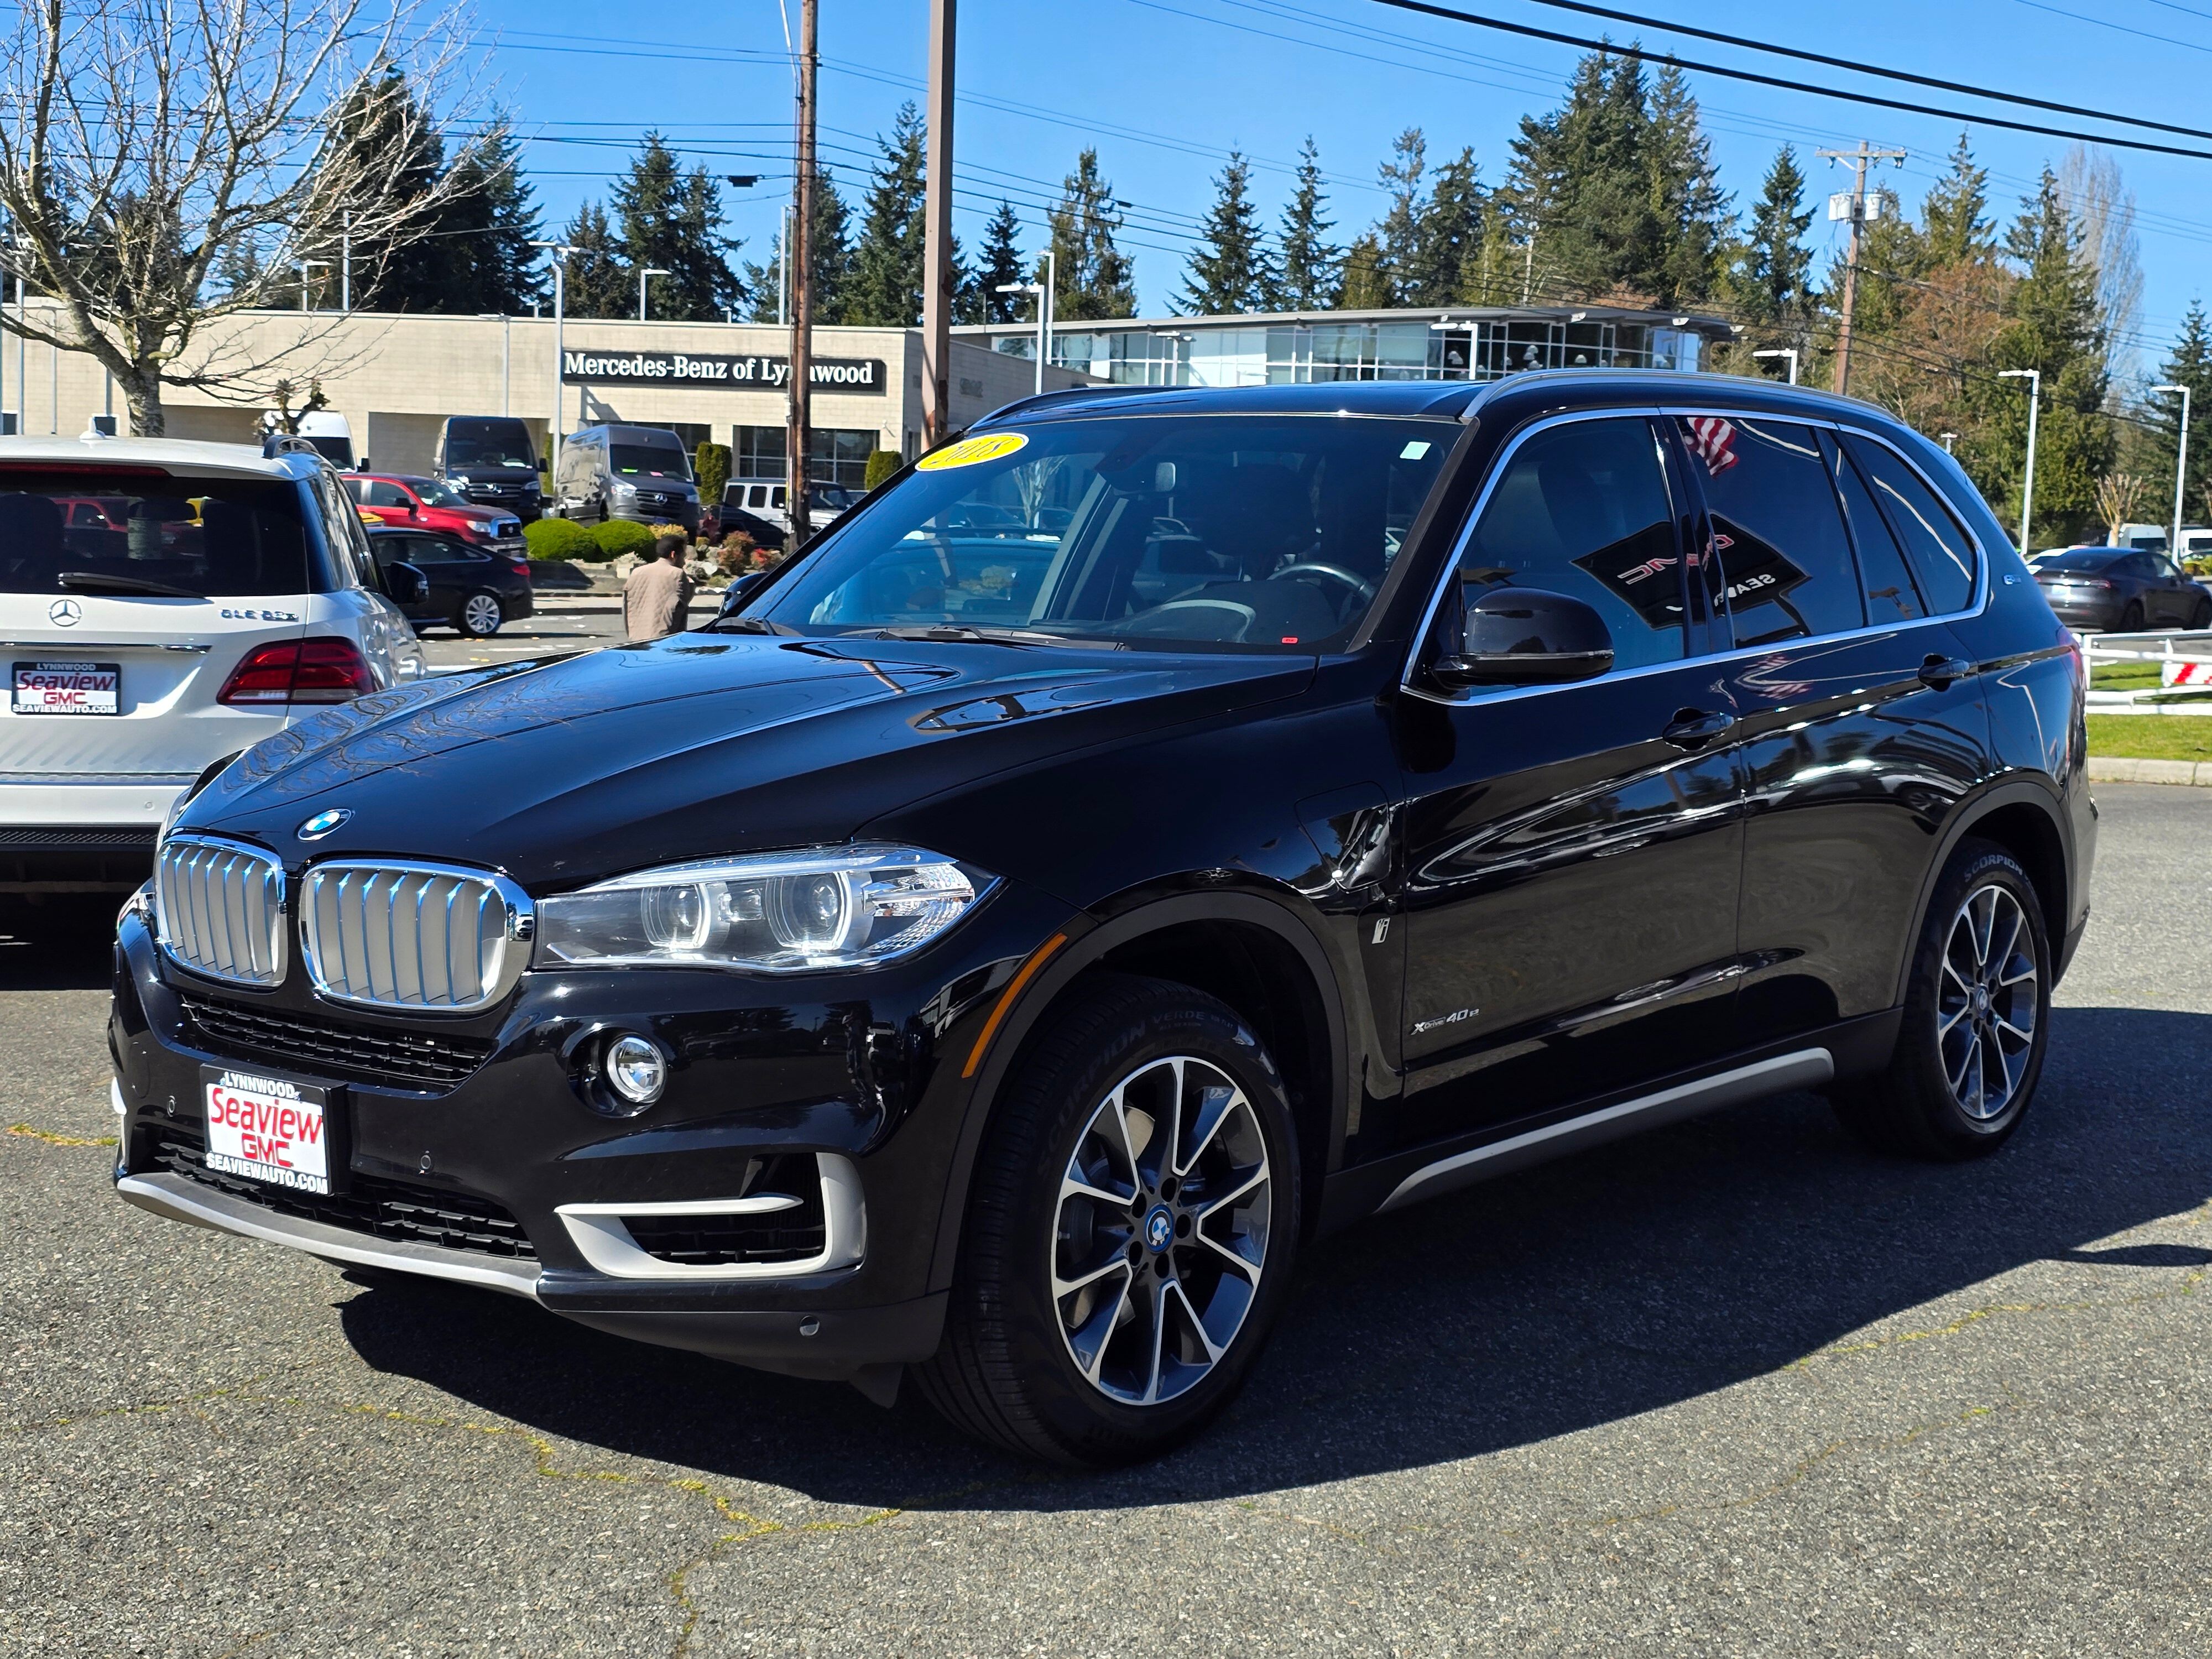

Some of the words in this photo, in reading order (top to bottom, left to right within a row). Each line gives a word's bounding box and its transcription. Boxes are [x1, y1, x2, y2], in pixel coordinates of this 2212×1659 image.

[564, 352, 727, 379] Mercedes-Benz
[733, 358, 756, 380] of
[761, 358, 873, 386] Lywood
[36, 663, 96, 671] LYNNWOOD
[17, 672, 115, 691] Seaview
[13, 704, 117, 714] SEAVIEWAUTO.COM
[44, 692, 88, 705] GMC
[1964, 854, 2023, 883] SCORPION
[1152, 1010, 1206, 1024] VERDE
[224, 1071, 296, 1099] LYNNWOOD
[211, 1087, 323, 1144] Seaview
[241, 1132, 295, 1168] GMC
[205, 1151, 329, 1196] SEAVIEWAUTO.COM
